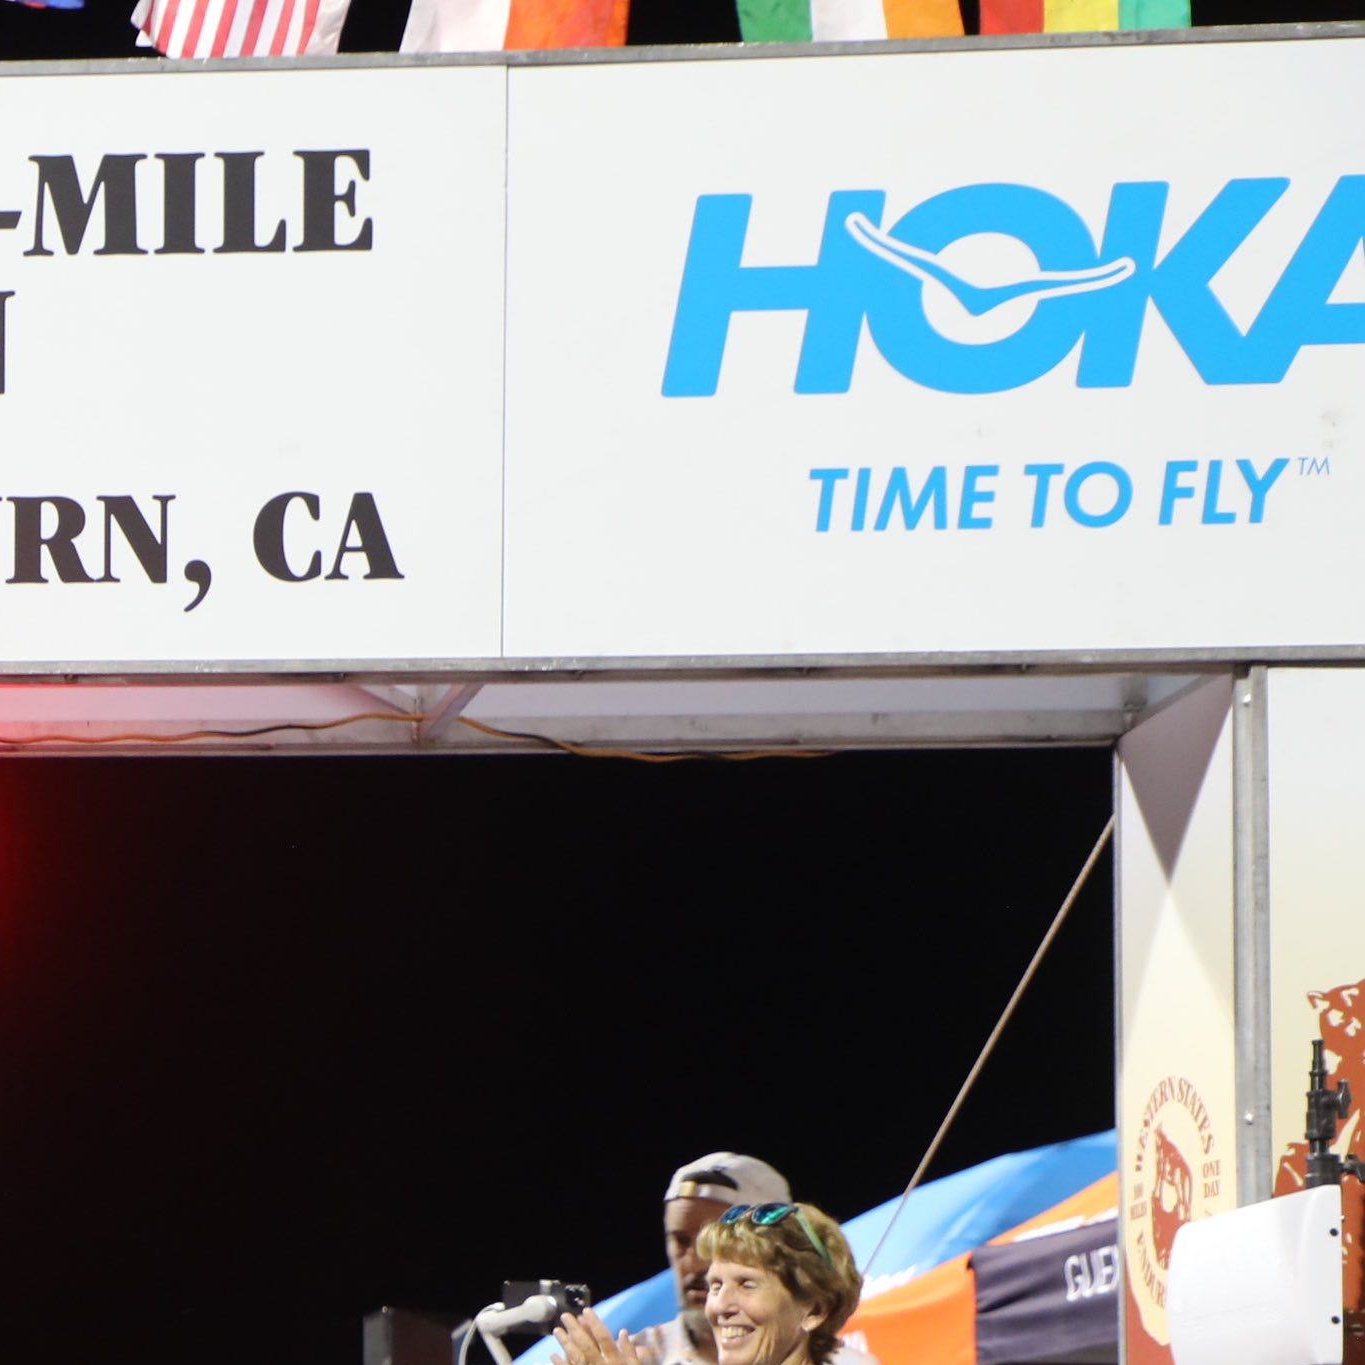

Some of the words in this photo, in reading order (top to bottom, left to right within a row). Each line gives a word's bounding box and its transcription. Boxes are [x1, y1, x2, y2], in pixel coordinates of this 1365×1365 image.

[660, 174, 1365, 398] HOKA
[252, 491, 405, 582] CA
[808, 464, 1000, 533] TIME
[1024, 460, 1134, 529] TO
[1203, 1160, 1221, 1178] ONE
